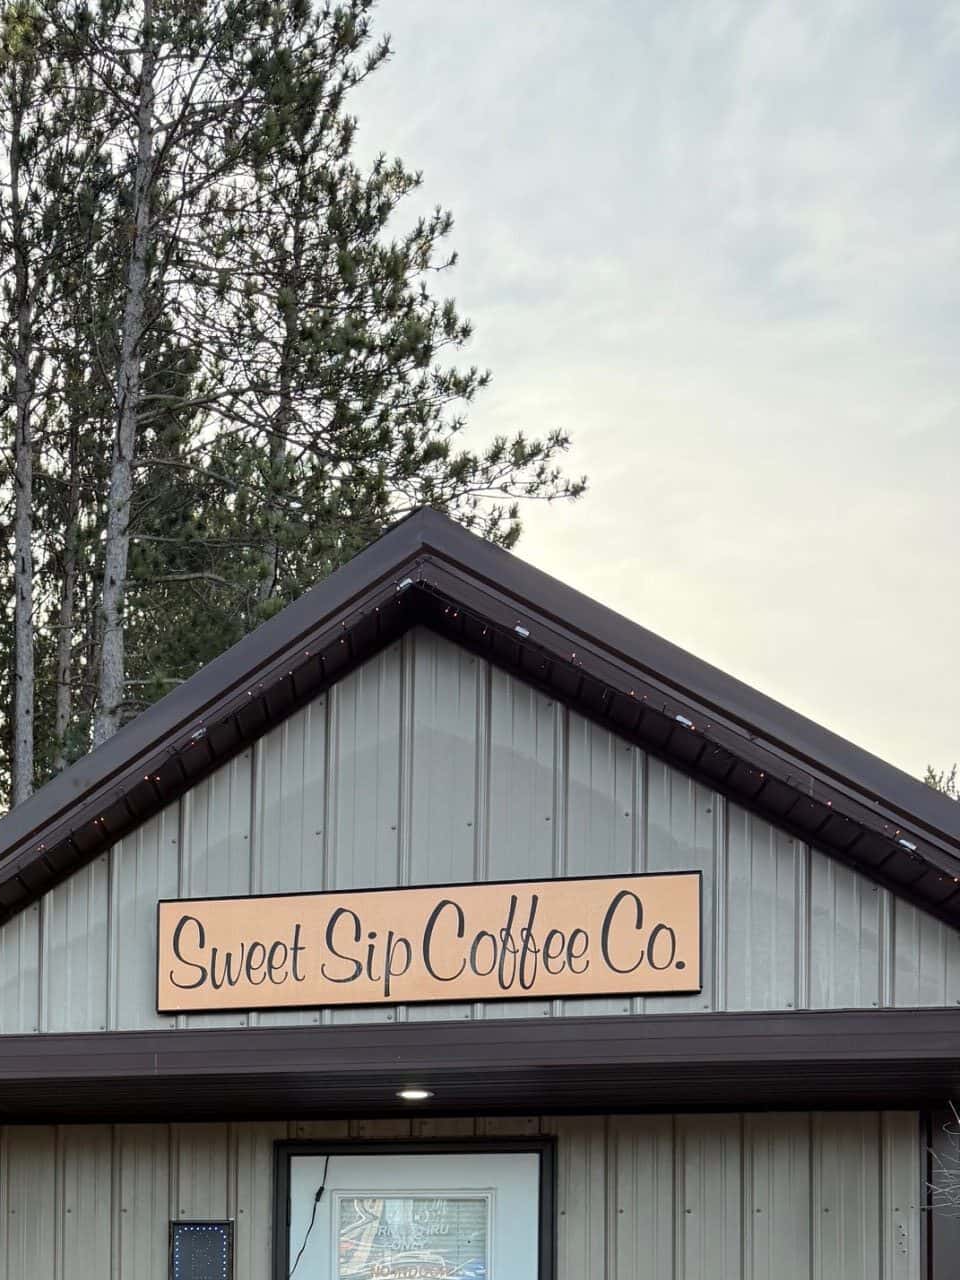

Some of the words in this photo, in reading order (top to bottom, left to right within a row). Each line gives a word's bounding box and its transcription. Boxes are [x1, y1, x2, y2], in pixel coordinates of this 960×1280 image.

[170, 914, 307, 990] Sweet
[321, 907, 413, 997] Sip
[422, 894, 590, 991] Coffee
[601, 890, 687, 974] Co.
